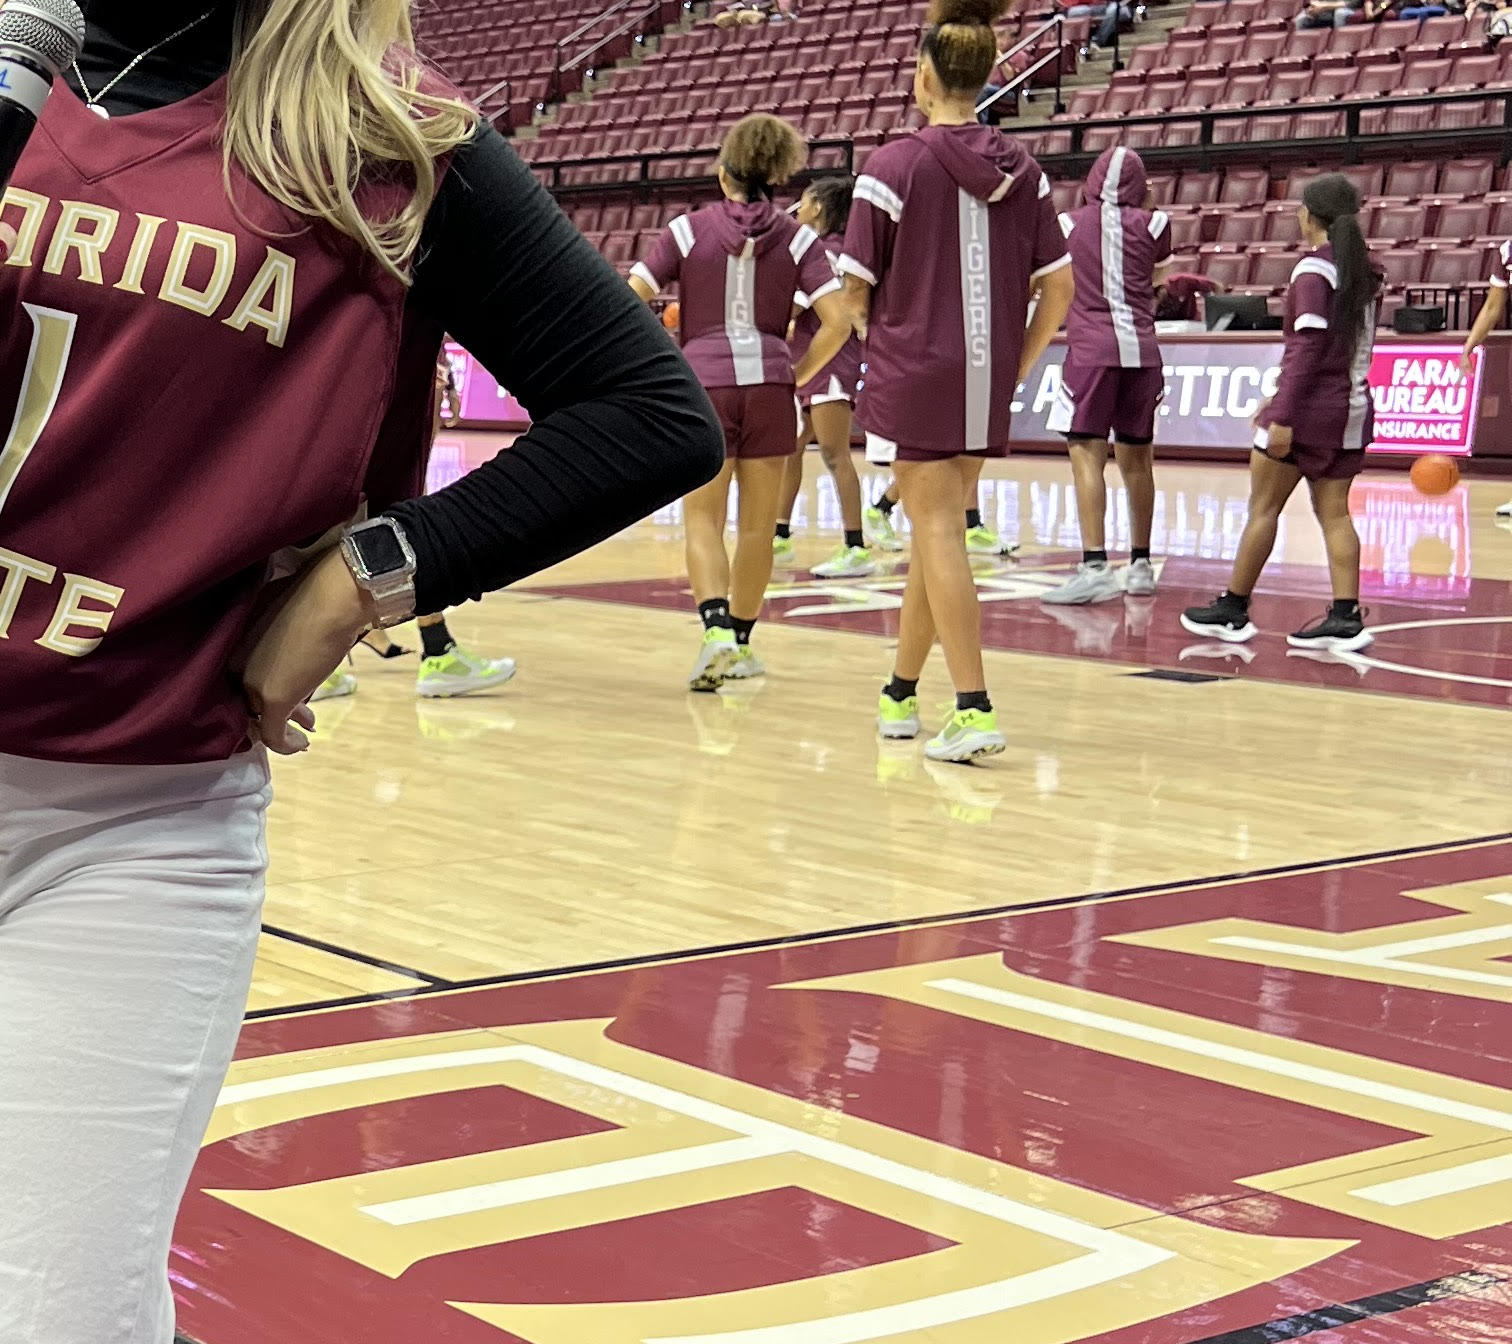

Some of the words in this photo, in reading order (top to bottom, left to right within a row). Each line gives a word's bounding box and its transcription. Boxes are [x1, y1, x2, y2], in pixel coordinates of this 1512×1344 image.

[967, 196, 988, 368] IGERS
[1369, 383, 1466, 414] UREAU
[1372, 420, 1462, 442] NSURANCE
